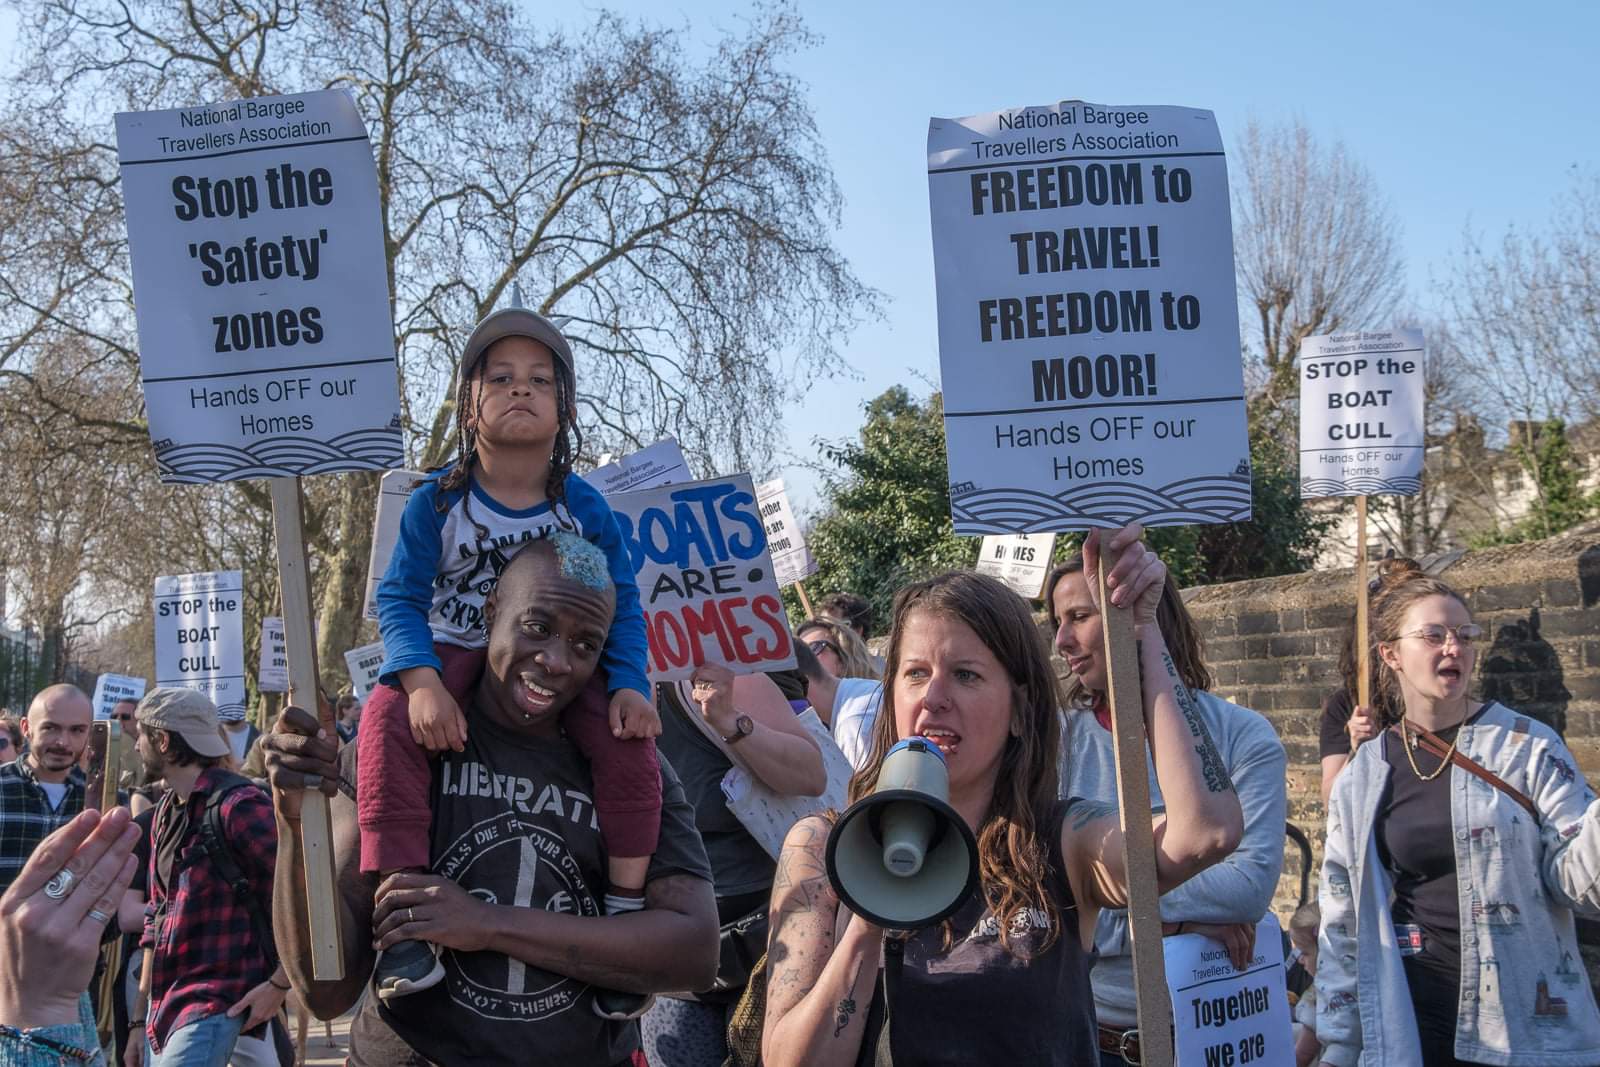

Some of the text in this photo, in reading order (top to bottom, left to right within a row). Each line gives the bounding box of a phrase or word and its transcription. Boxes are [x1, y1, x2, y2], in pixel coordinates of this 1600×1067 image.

[180, 99, 305, 128] National Bargee
[998, 106, 1149, 131] National Bargee
[158, 120, 331, 154] Travellers Association
[971, 131, 1179, 160] Travellers Association
[172, 163, 334, 222] Stop the
[970, 163, 1192, 215] FREEDOM to
[189, 229, 328, 287] 'Safety'
[1010, 225, 1160, 275] TRAVEL!
[212, 306, 324, 353] zones
[979, 290, 1201, 343] FREEDOM to
[1032, 353, 1157, 402] MOOR!
[1306, 358, 1416, 379] STOP the
[190, 378, 357, 409] Hands OFF our
[1328, 390, 1392, 409] BOAT
[241, 413, 314, 436] Homes
[995, 416, 1196, 448] Hands OFF our
[1328, 422, 1392, 440] CULL
[1053, 455, 1144, 480] Homes
[1319, 451, 1403, 464] Hands OFF our
[1341, 467, 1380, 476] Homes
[612, 483, 767, 575] BOATS
[771, 519, 785, 533] are
[768, 536, 792, 555] strong
[159, 597, 237, 617] STOP the
[177, 626, 220, 644] BOAT
[178, 656, 220, 673] CULL
[442, 761, 600, 832] LIBERAT
[474, 825, 499, 845] DIE
[1192, 965, 1231, 981] Travellers
[462, 985, 502, 1010] NOT
[1191, 985, 1269, 1029] Together
[1204, 1032, 1265, 1067] we are
